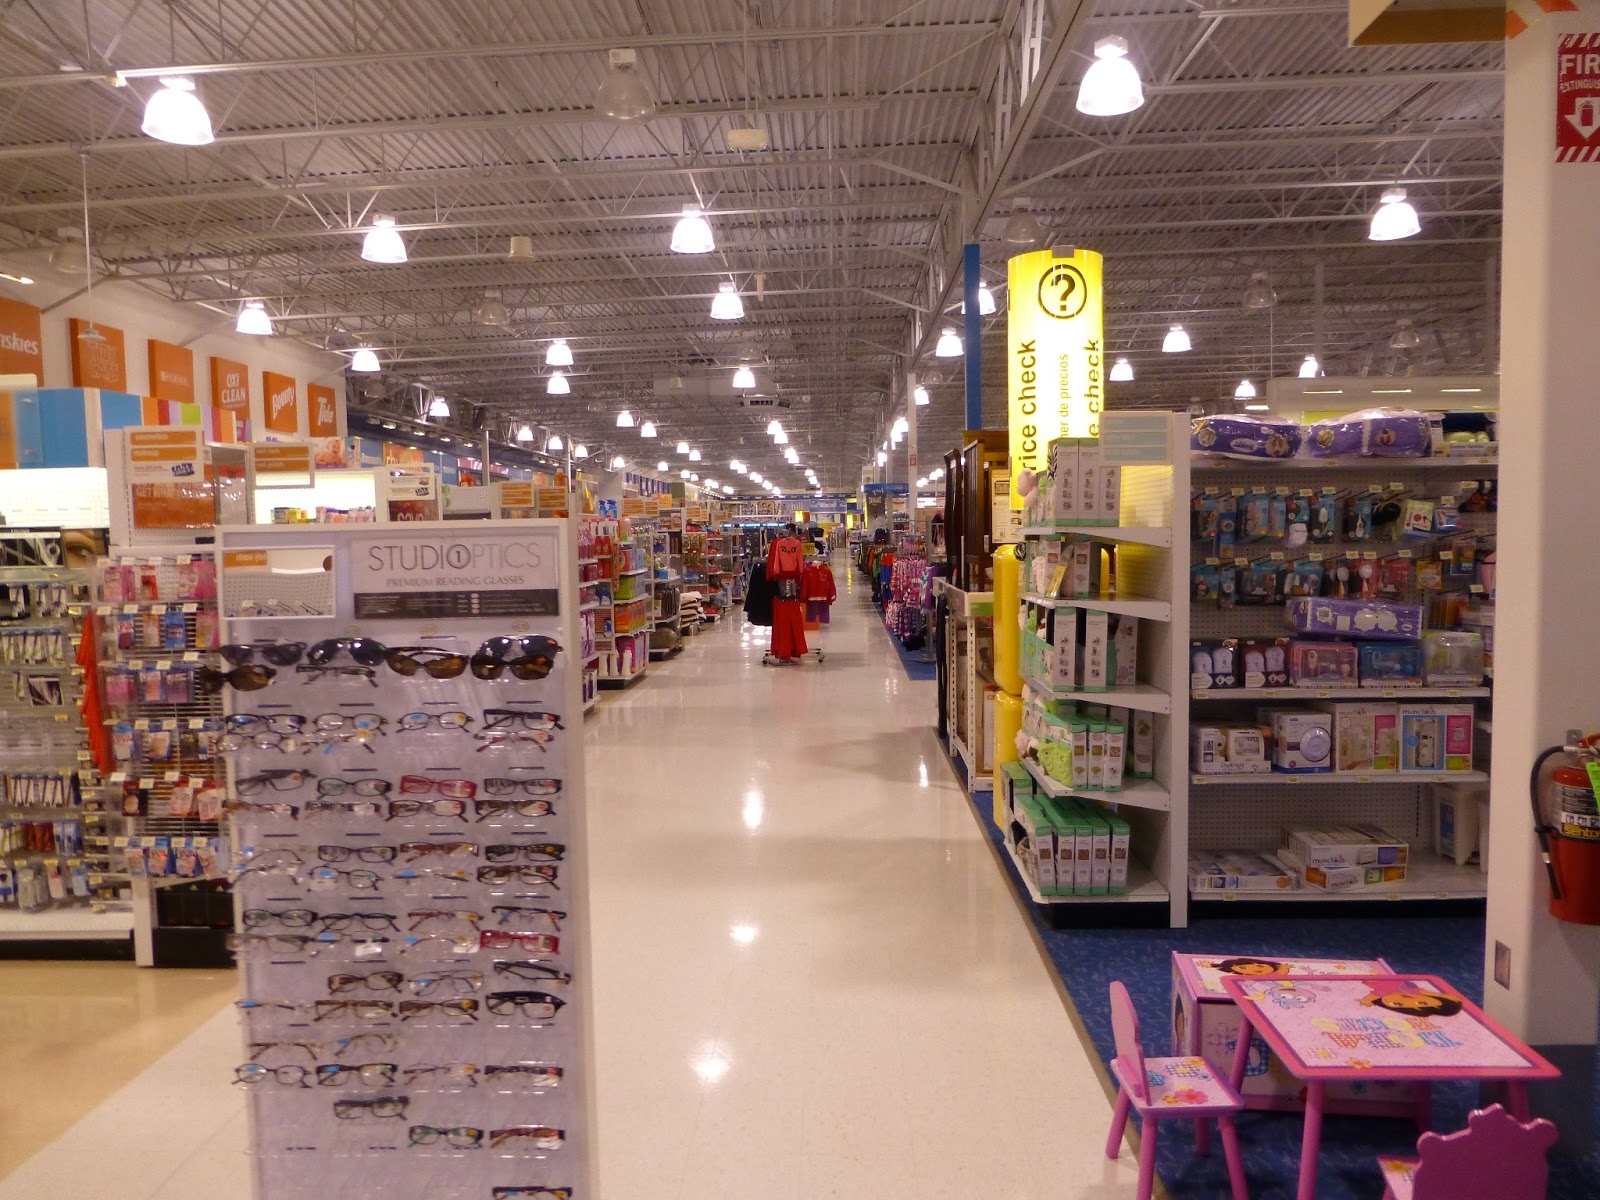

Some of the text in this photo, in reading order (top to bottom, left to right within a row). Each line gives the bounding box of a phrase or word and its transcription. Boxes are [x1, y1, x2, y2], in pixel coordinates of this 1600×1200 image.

[1561, 53, 1600, 75] FIR
[226, 372, 240, 388] OXI
[1056, 353, 1071, 398] precios
[1083, 339, 1099, 414] check
[221, 386, 246, 404] CLEAN
[272, 384, 295, 420] Bounty
[1017, 339, 1037, 471] rice check
[318, 396, 334, 426] Tide
[1057, 402, 1069, 418] de
[386, 575, 525, 587] PREMIUM READING GLASSES
[1402, 706, 1436, 715] munchkin
[1312, 855, 1346, 864] munchkin
